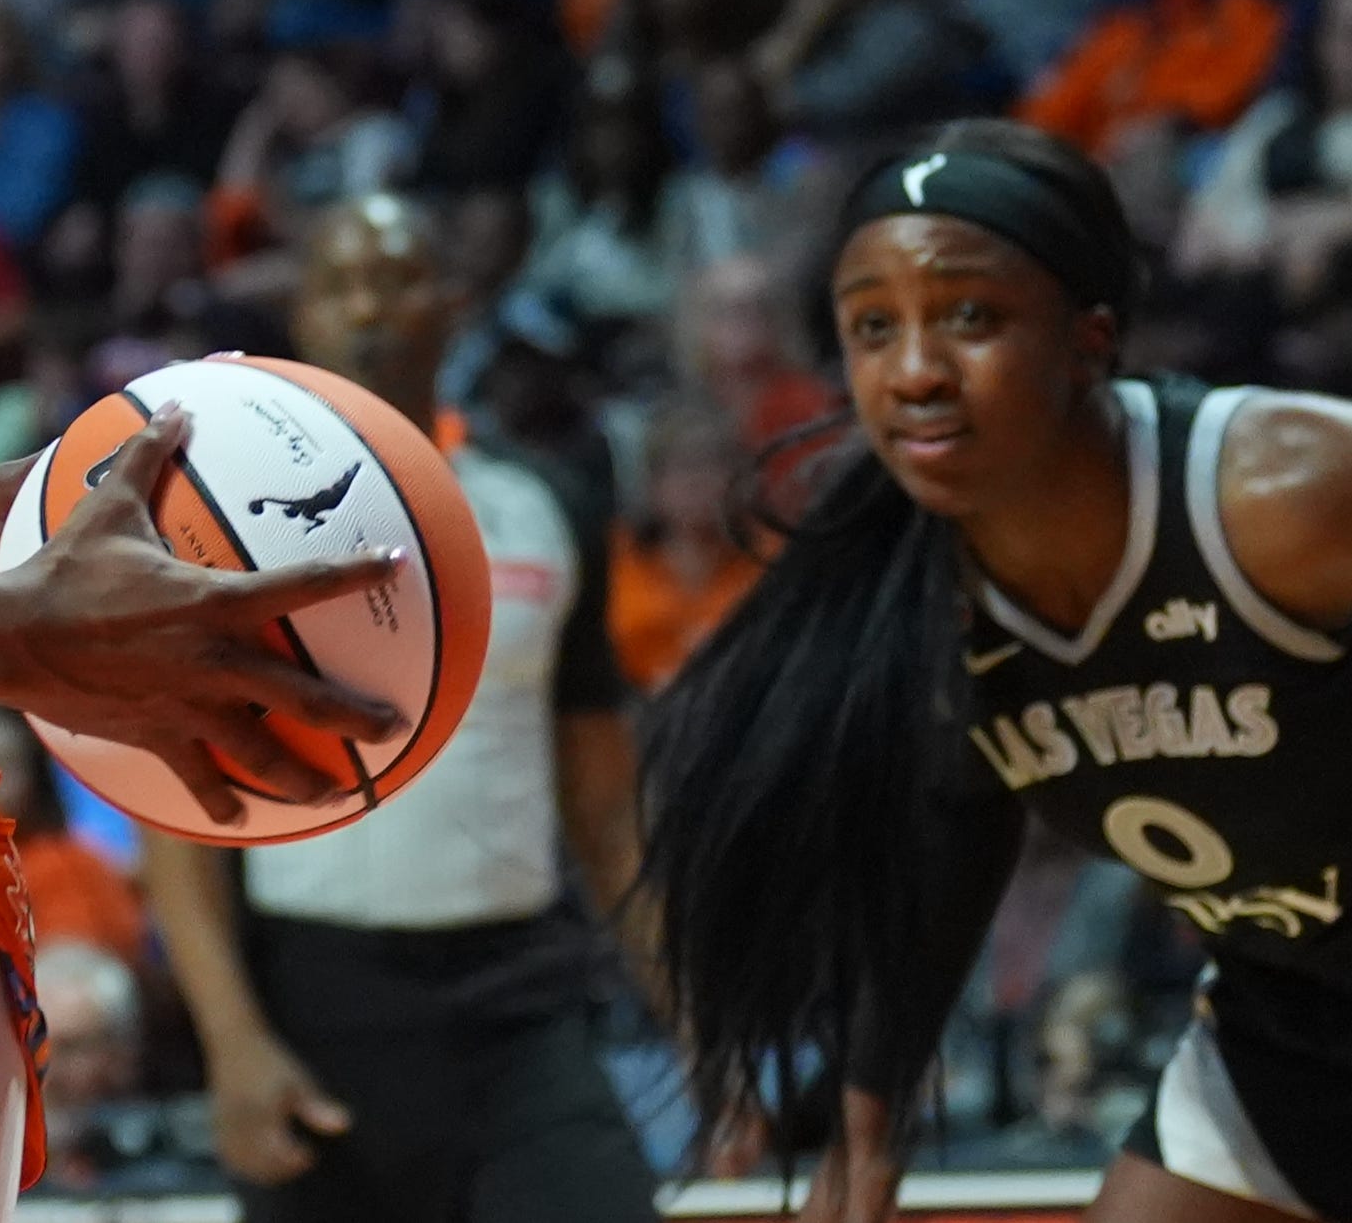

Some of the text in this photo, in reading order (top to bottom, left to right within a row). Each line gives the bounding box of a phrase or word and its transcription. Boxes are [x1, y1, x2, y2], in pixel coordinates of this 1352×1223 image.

[967, 681, 1280, 790] LAS VEGAS
[1102, 794, 1234, 890] 0
